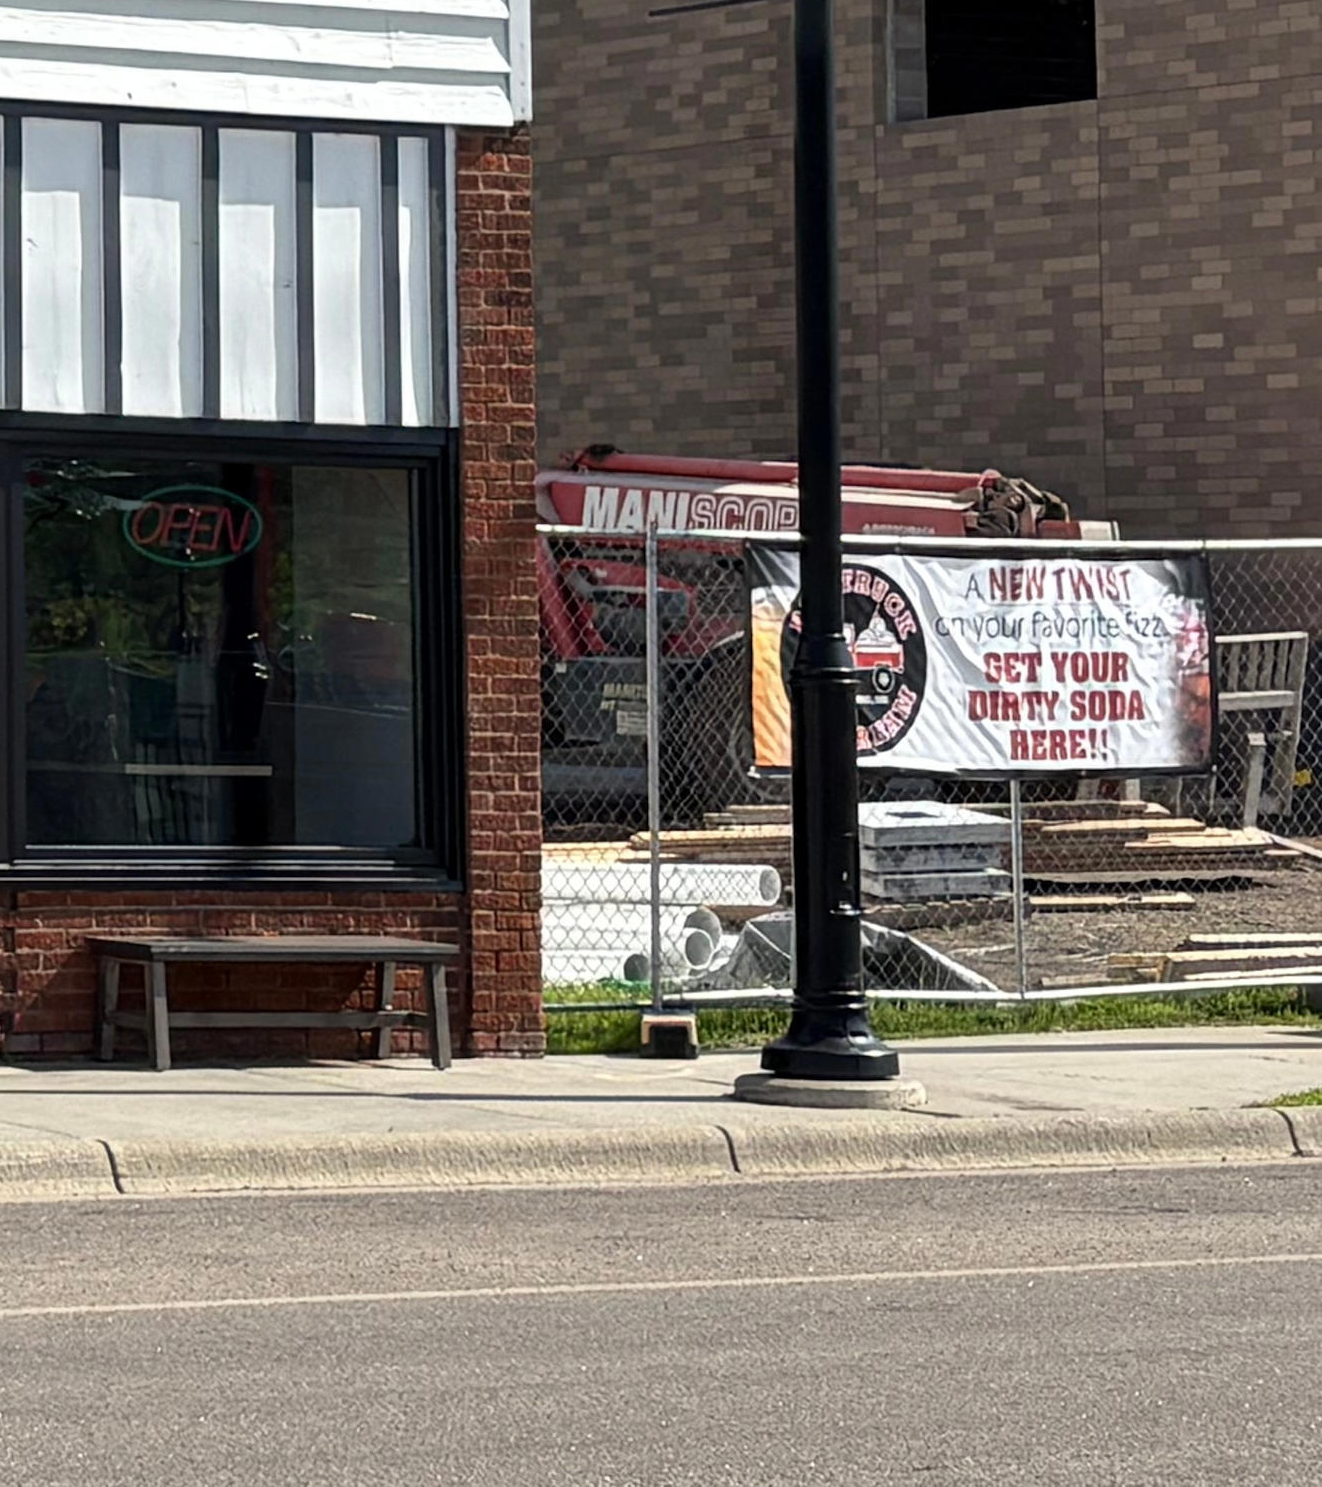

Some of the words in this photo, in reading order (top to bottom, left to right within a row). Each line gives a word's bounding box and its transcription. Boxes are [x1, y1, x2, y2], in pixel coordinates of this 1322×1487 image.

[582, 486, 800, 532] MANISCOP
[132, 501, 252, 553] OPEN
[965, 575, 985, 600] A
[989, 567, 1046, 601] NEW
[1052, 568, 1131, 601] TWIST
[936, 617, 965, 636] on
[975, 616, 1025, 641] your
[1032, 611, 1120, 640] favorite
[983, 652, 1042, 683] GET
[1051, 652, 1129, 683] YOUR
[968, 690, 1060, 721] DIRTY
[1070, 690, 1146, 721] SODA
[1009, 728, 1108, 761] HERE!!
